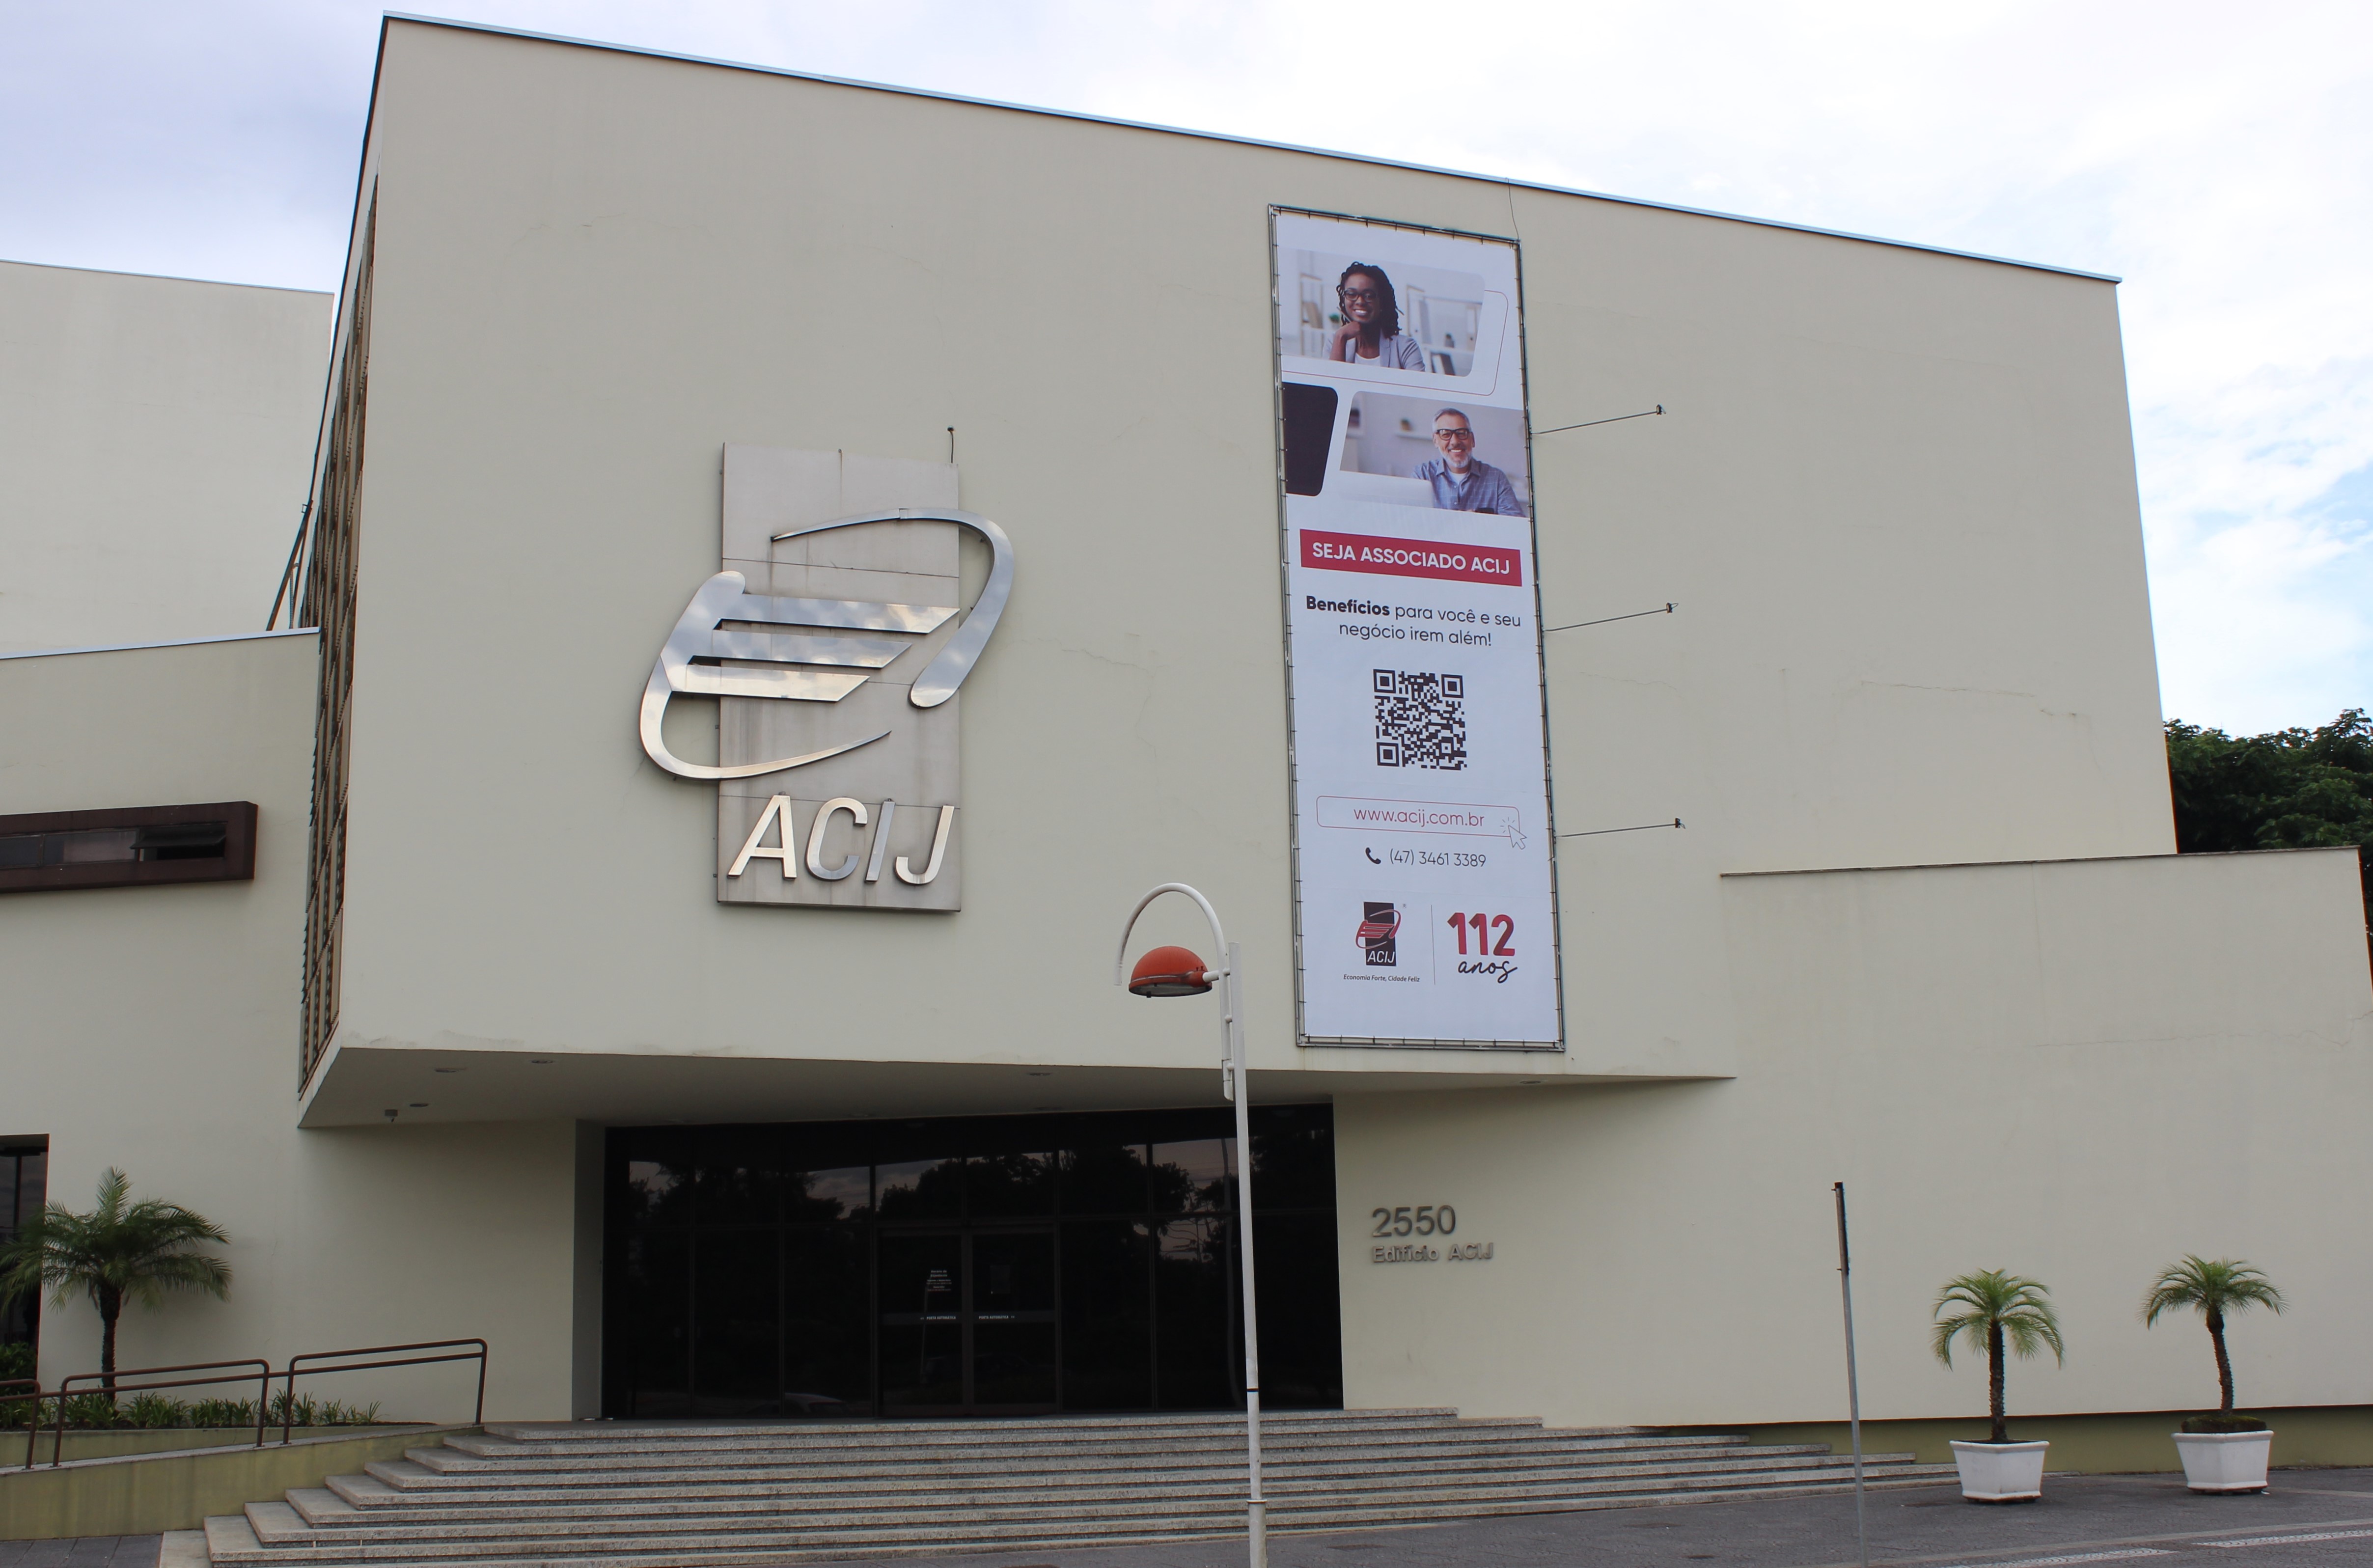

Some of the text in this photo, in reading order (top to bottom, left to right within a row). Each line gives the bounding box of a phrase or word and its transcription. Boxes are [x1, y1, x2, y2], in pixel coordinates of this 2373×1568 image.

[1312, 542, 1510, 574] SEJA ASSOCIADO ACIJ
[1306, 596, 1520, 627] Benefícios para você e seu
[1339, 622, 1491, 646] negócio irem além!
[1354, 808, 1484, 827] www.acij.com.br
[727, 794, 955, 884] ACIJ
[1389, 849, 1486, 867] (47) 3461 3389
[1447, 912, 1516, 956] 112
[1367, 950, 1395, 963] ACIJ
[1458, 960, 1518, 984] anos
[1372, 1205, 1456, 1237] 2550
[1373, 1242, 1494, 1263] Edifício ACIJ
